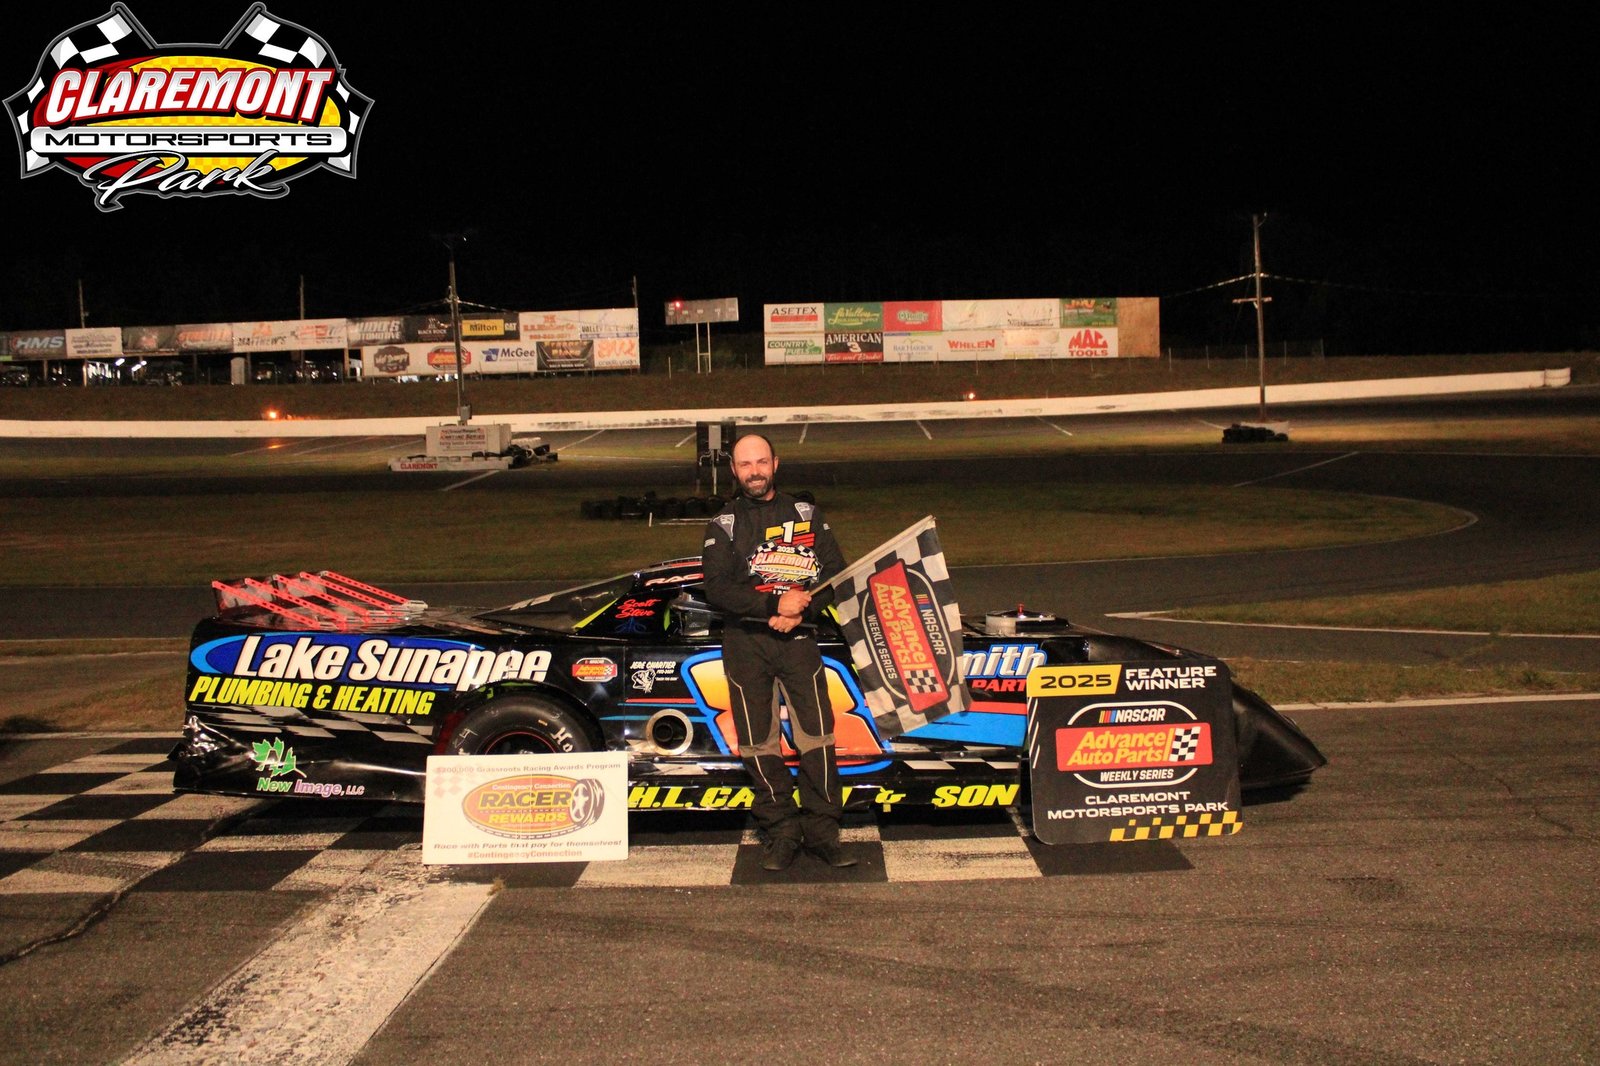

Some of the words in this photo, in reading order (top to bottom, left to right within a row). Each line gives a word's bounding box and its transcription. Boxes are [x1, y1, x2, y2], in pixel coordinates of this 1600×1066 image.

[470, 322, 497, 332] Milton
[15, 336, 65, 349] HMS
[825, 333, 881, 345] AMERICAN
[847, 341, 861, 352] 3
[948, 339, 996, 349] WHELEN
[1068, 329, 1108, 349] MAC
[501, 348, 535, 358] McGee
[783, 521, 794, 543] 1
[755, 552, 816, 571] CLAREMONT
[874, 582, 893, 621] Auto
[886, 621, 911, 664] Parts
[890, 585, 926, 663] Advance
[921, 609, 947, 655] NASCAR
[867, 614, 886, 648] WEEKLY
[878, 648, 898, 680] SERIES
[234, 635, 351, 680] Lake
[351, 639, 552, 692] Sunapee
[963, 645, 1045, 677] mith
[1125, 666, 1217, 680] FEATURE
[972, 680, 1027, 692] PART
[1040, 674, 1112, 689] 2025
[1125, 678, 1206, 691] WINNER
[189, 676, 312, 709] PLUMBING
[313, 685, 330, 709] &
[332, 686, 436, 715] HEATING
[1115, 708, 1166, 723] NASCAR
[1078, 729, 1166, 749] Advance
[1067, 749, 1113, 766] Auto
[1114, 747, 1163, 763] Parts
[477, 765, 521, 773] Grassroots
[523, 765, 551, 774] Racing
[553, 763, 584, 771] Awards
[586, 762, 621, 771] Program
[1100, 770, 1139, 782] WEEKLY
[1139, 769, 1174, 780] SERIES
[257, 778, 291, 793] New
[345, 785, 365, 795] LLC
[479, 791, 572, 808] RACER
[932, 784, 1019, 808] SON
[1085, 791, 1190, 805] CLAREMONT
[488, 813, 568, 824] REWARDS
[1047, 805, 1180, 820] MOTORSPORTS
[1185, 802, 1229, 813] PARK
[531, 842, 548, 851] pay
[566, 840, 622, 848] themselves!
